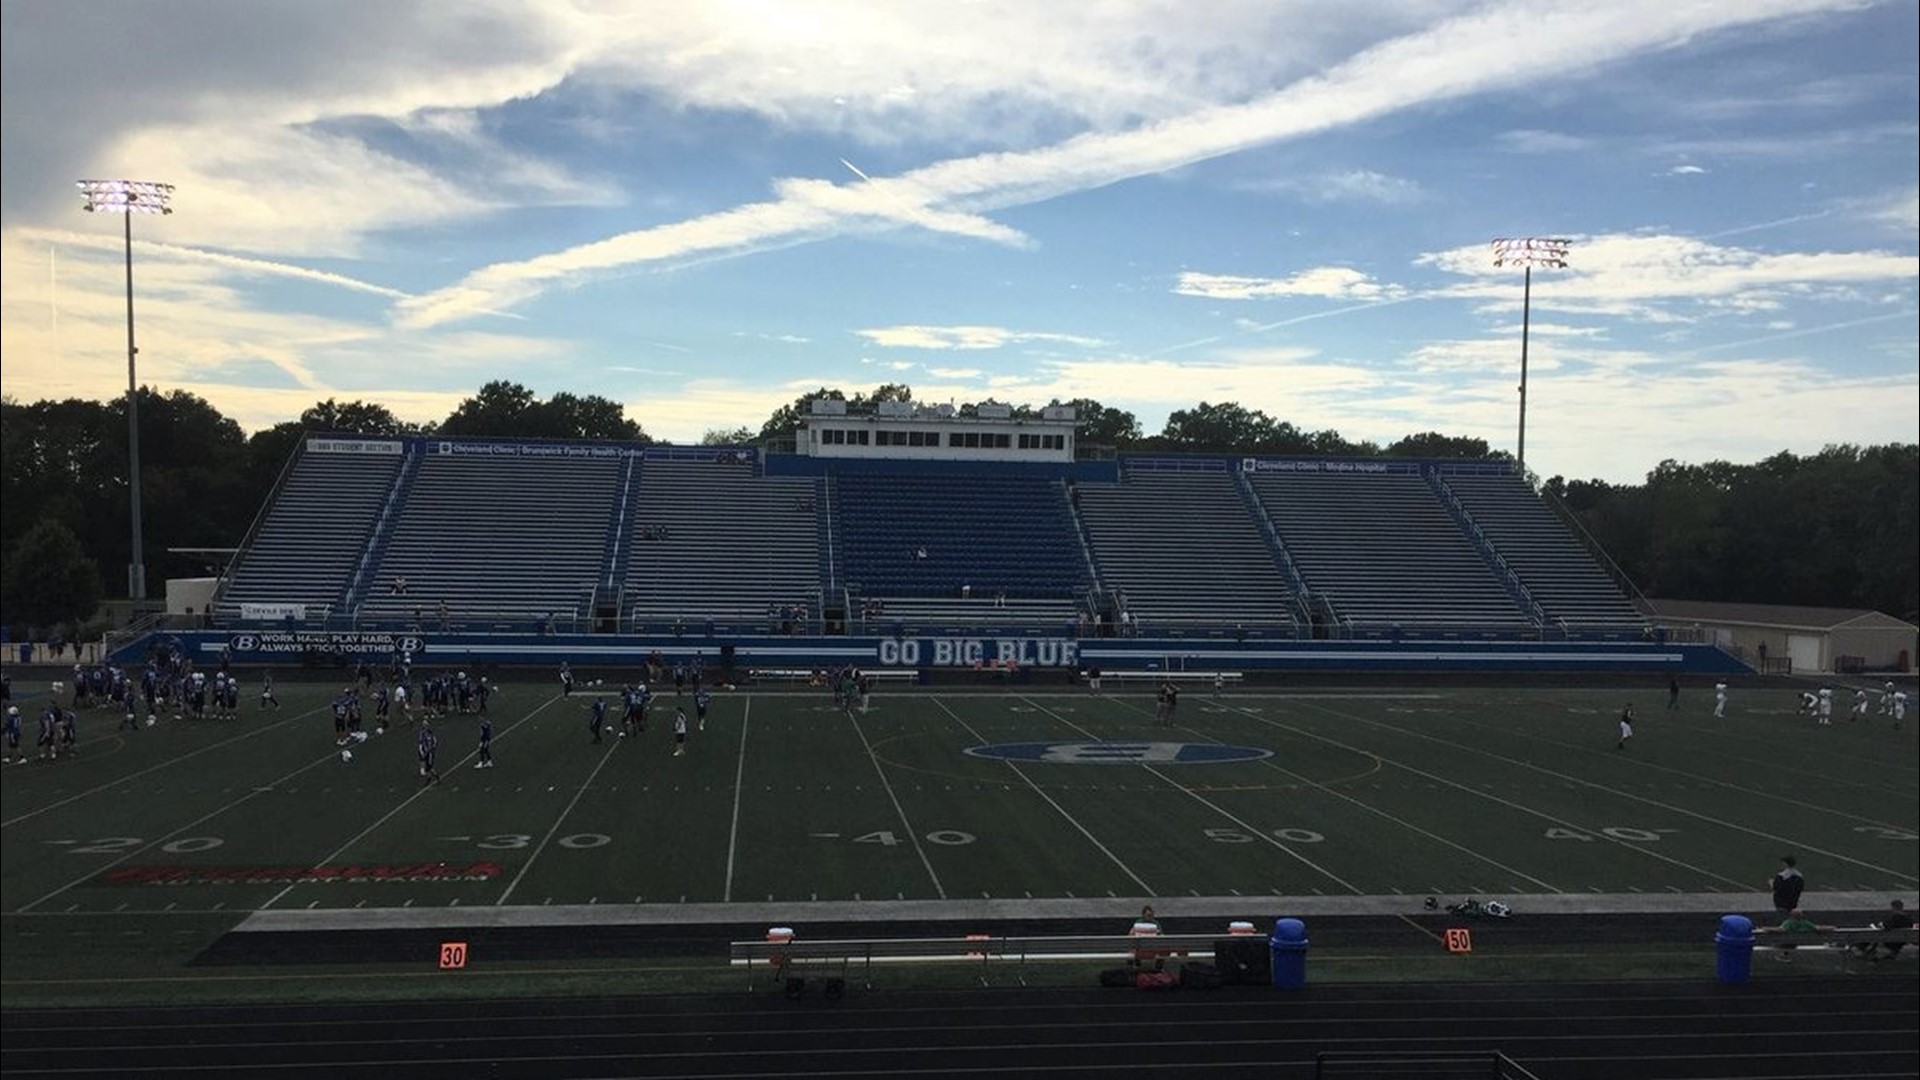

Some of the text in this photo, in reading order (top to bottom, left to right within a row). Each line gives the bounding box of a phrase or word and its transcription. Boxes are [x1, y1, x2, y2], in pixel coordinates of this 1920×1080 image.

[453, 444, 493, 455] Cleveland
[494, 446, 515, 455] Clinic
[521, 446, 562, 456] Brunswick
[564, 447, 589, 458] Family
[591, 448, 615, 457] Health
[1257, 460, 1295, 471] Cleveland
[1296, 461, 1319, 471] Clinic
[260, 634, 295, 643] WORK
[332, 635, 360, 644] PLAY
[259, 643, 304, 652] ALWAYS
[339, 644, 395, 653] TOGETHER
[879, 638, 920, 666] GO
[932, 639, 984, 667] BIG
[477, 834, 611, 849] 30
[852, 831, 975, 845] 40
[1205, 828, 1325, 843] 50
[68, 837, 224, 853] 20
[1450, 930, 1469, 949] 50
[443, 946, 463, 966] 30
